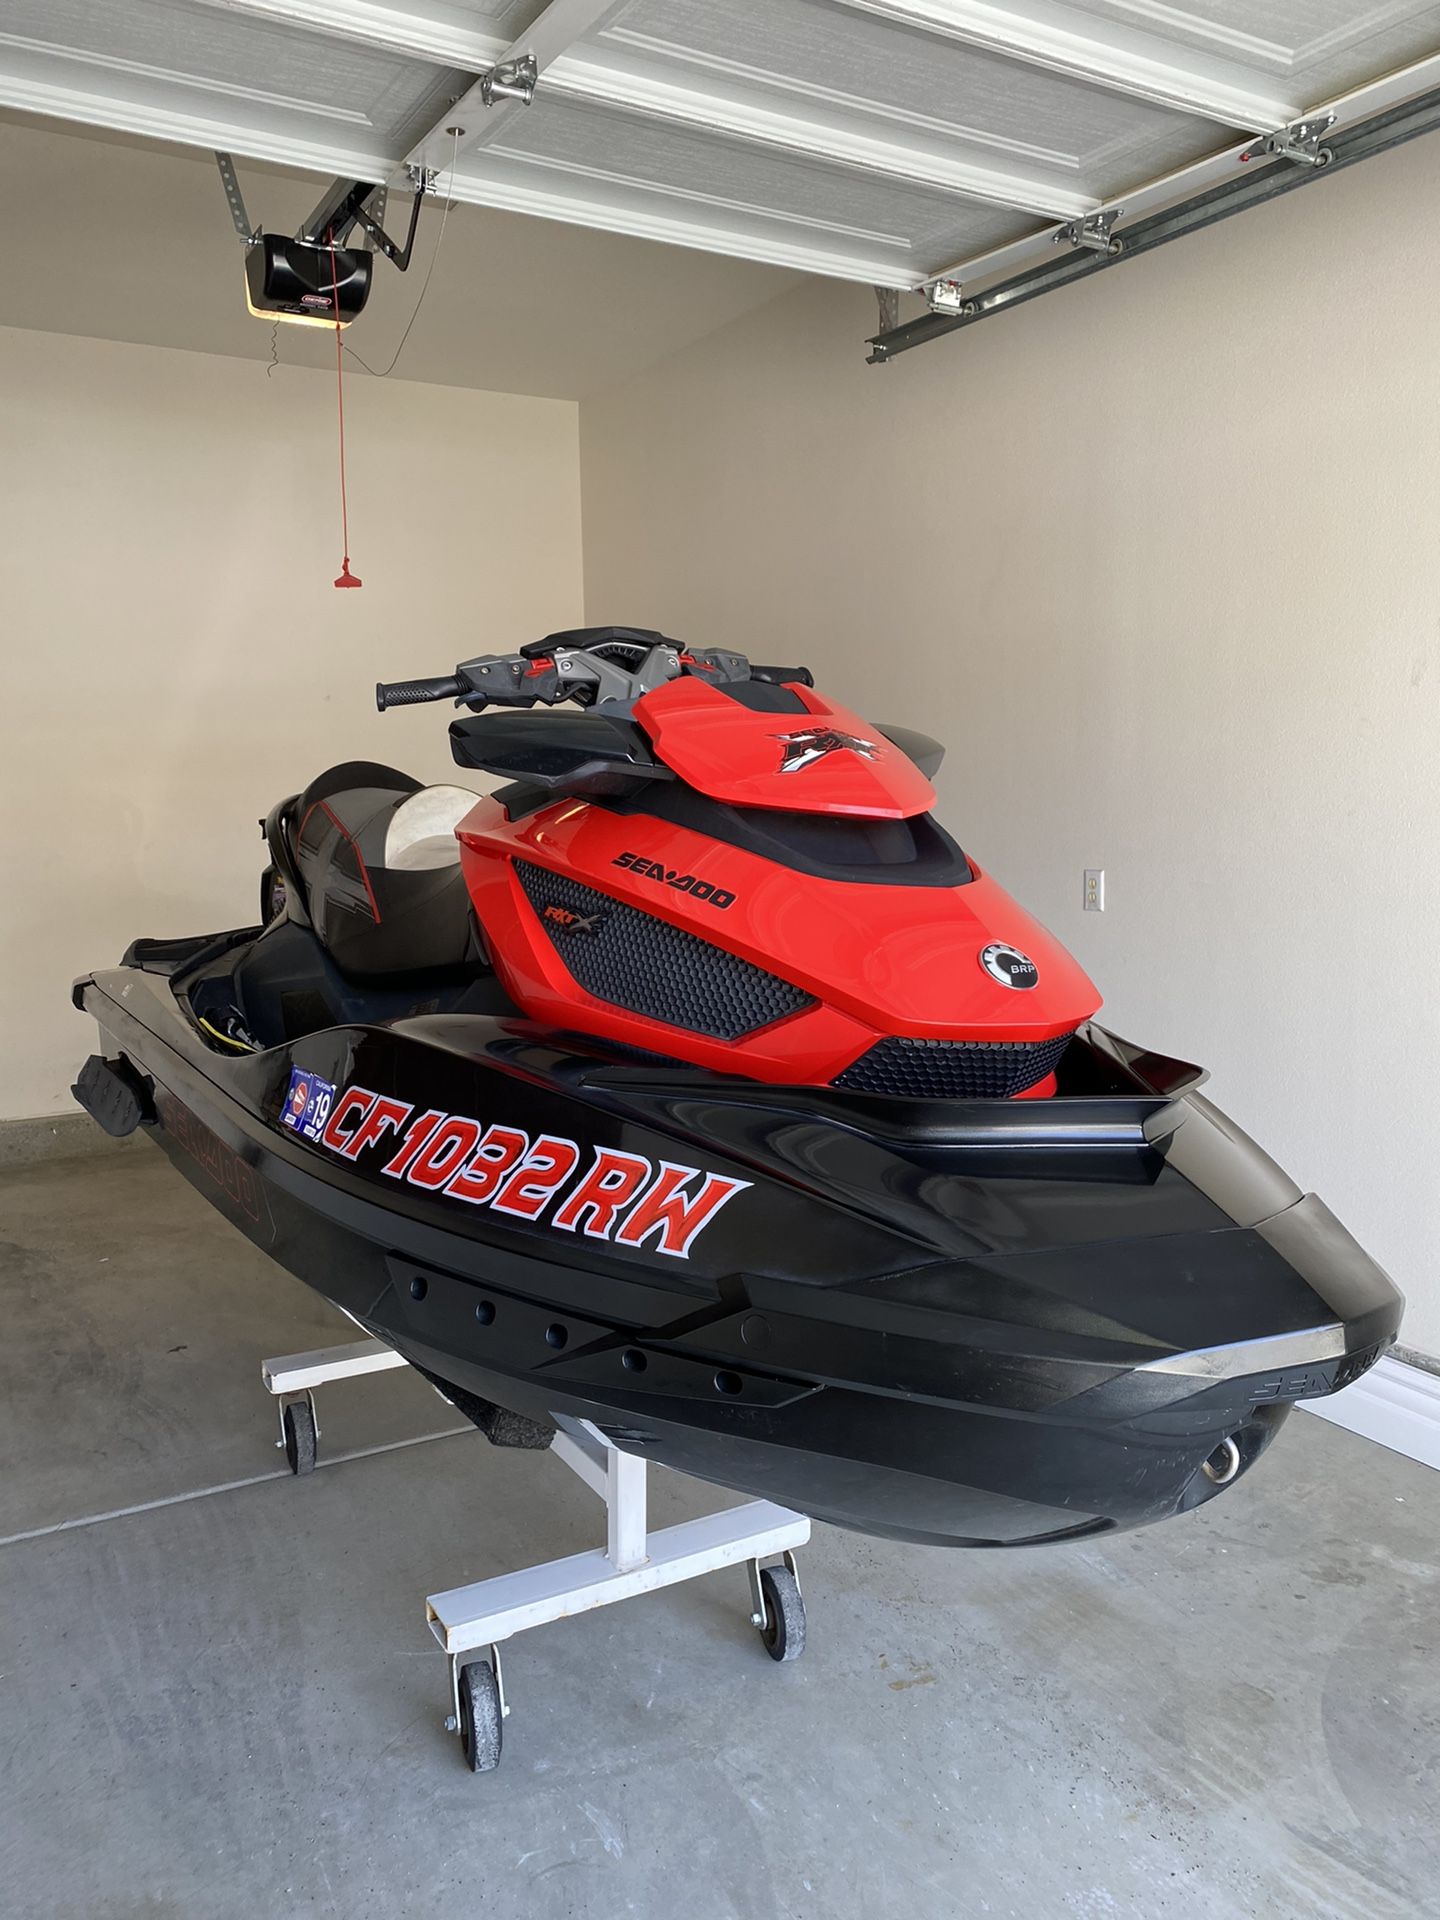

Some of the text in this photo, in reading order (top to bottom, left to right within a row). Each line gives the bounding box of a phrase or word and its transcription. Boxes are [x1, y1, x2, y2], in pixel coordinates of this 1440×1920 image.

[1010, 964, 1036, 974] BRP
[311, 1091, 331, 1130] 19
[322, 1085, 755, 1260] CF 1032 RW
